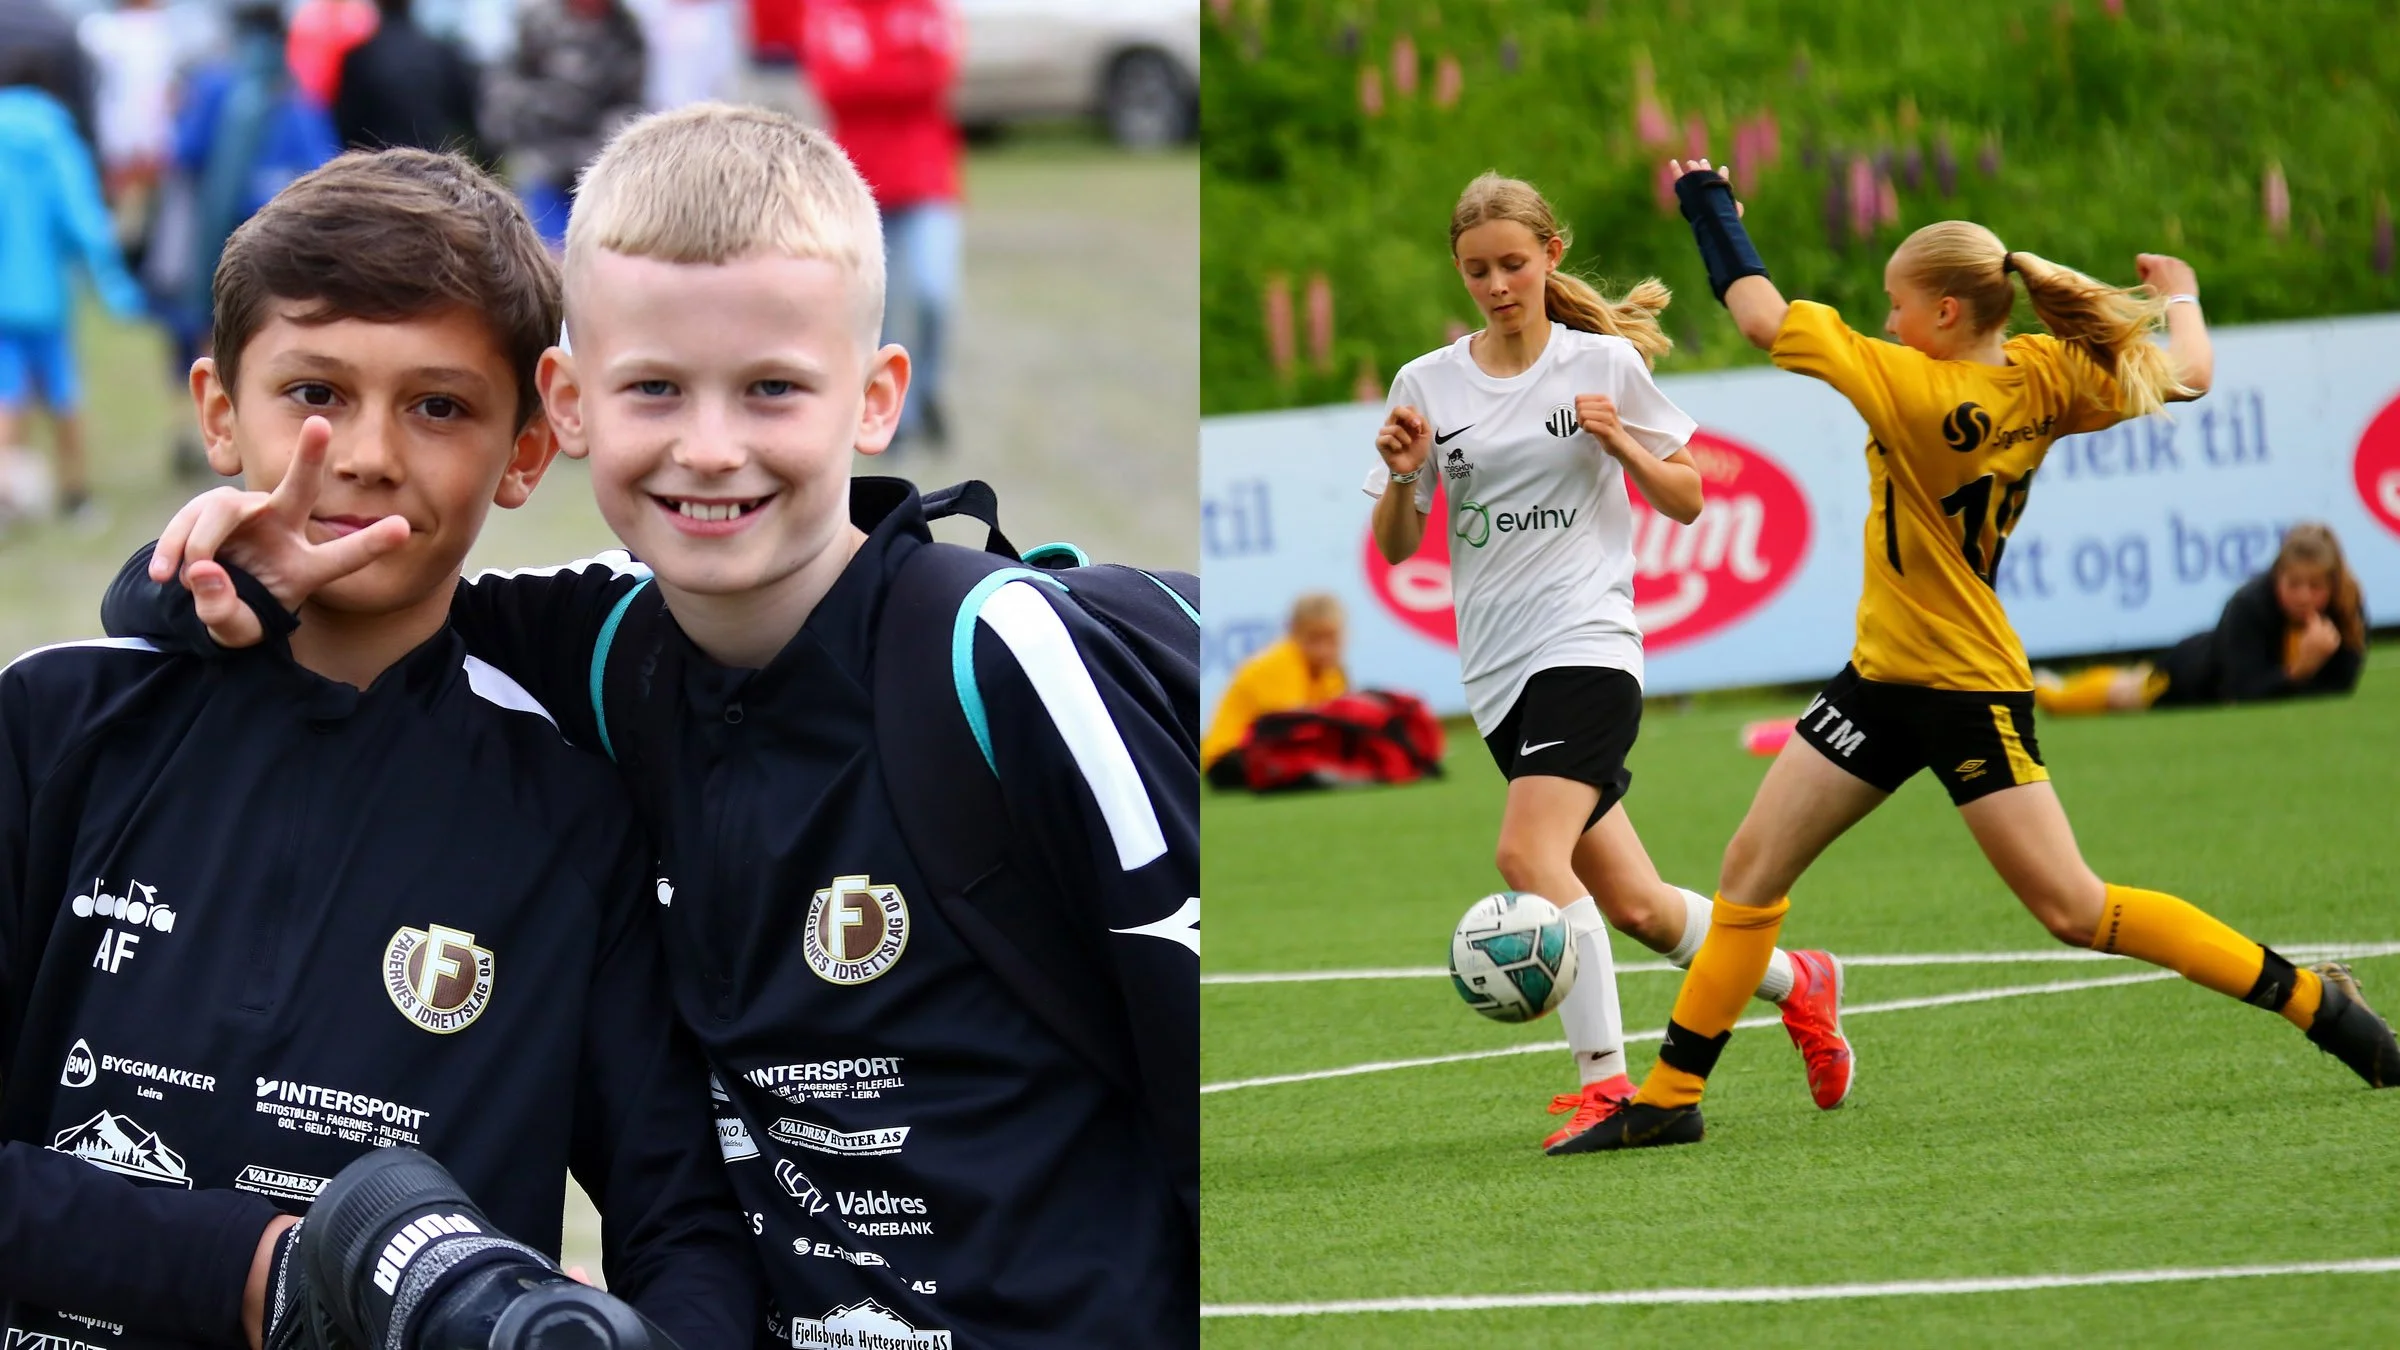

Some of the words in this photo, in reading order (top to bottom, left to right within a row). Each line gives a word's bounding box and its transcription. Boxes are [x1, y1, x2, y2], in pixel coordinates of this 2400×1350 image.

[2202, 385, 2272, 467] til
[1450, 471, 1471, 480] SPORT
[2071, 532, 2149, 609] og
[72, 877, 176, 934] diadora
[806, 895, 830, 972] FAGERNES
[832, 917, 904, 980] IDRETTSLAG
[880, 891, 900, 913] 04
[92, 927, 140, 975] AF
[388, 932, 417, 1010] FAGERNES
[414, 981, 489, 1029] IDRETTSLAG
[478, 956, 491, 977] 04
[67, 1055, 91, 1076] BM
[101, 1054, 216, 1092] BYGGMAKKER
[749, 1057, 901, 1088] INTERSPORT
[137, 1085, 164, 1101] Leira
[797, 1082, 848, 1093] FAGERNES
[855, 1077, 905, 1090] FILEFJELL
[812, 1090, 844, 1099] VASET
[851, 1090, 881, 1099] LEIRA
[279, 1080, 426, 1130] INTERSPORT
[255, 1101, 320, 1122] BEITOSTØLEN
[326, 1113, 374, 1133] FAGERNES
[379, 1125, 421, 1145] FILEFJELL
[277, 1117, 298, 1131] GOL
[304, 1121, 332, 1137] GEILO
[338, 1127, 368, 1144] VASET
[780, 1120, 827, 1142] VALDRES
[880, 1131, 902, 1144] AS
[247, 1168, 319, 1192] VALDRES
[835, 1190, 928, 1216] Valdres
[841, 1219, 934, 1237] PAREBANK
[373, 1213, 482, 1297] PUMA
[911, 1280, 938, 1295] AS
[795, 1321, 855, 1349] Fjellsbygda
[858, 1329, 930, 1350] Hytteservice
[932, 1334, 949, 1350] AS
